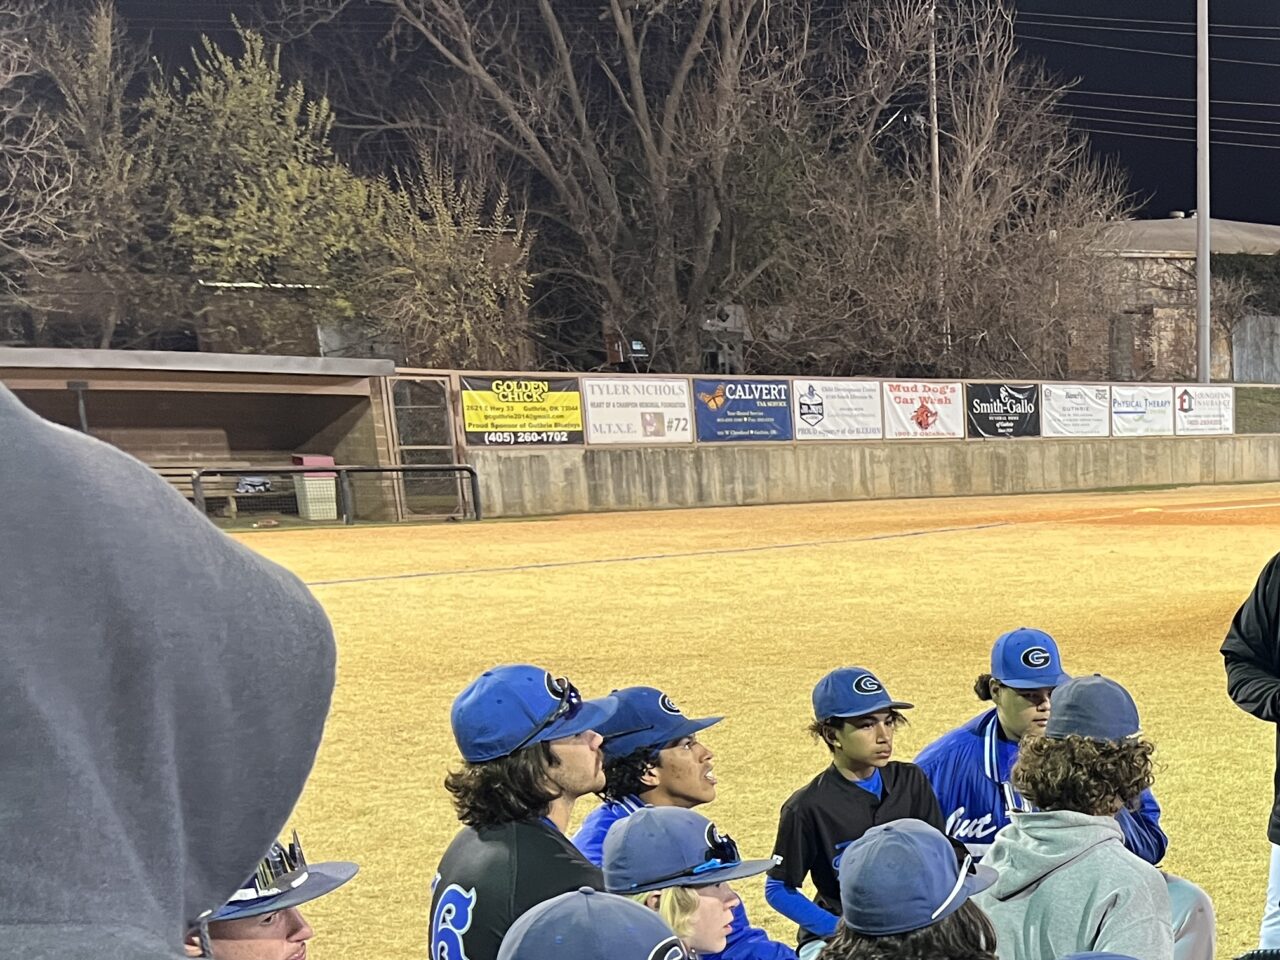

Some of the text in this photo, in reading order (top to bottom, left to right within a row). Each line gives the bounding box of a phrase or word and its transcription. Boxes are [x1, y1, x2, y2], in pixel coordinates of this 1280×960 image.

[492, 380, 549, 393] GOLDEN
[588, 384, 686, 396] TYLER NICHOLS
[725, 384, 788, 400] CALVERT
[888, 384, 956, 394] Mud Dog's
[498, 391, 544, 403] CHICK
[894, 396, 915, 405] Car
[1113, 398, 1171, 409] PHYSICAL THERAPY
[973, 398, 1034, 413] Smith-Gallo
[666, 417, 689, 432] #72
[484, 432, 569, 445] (405) 260-1702
[1020, 646, 1051, 669] G
[853, 674, 884, 695] G
